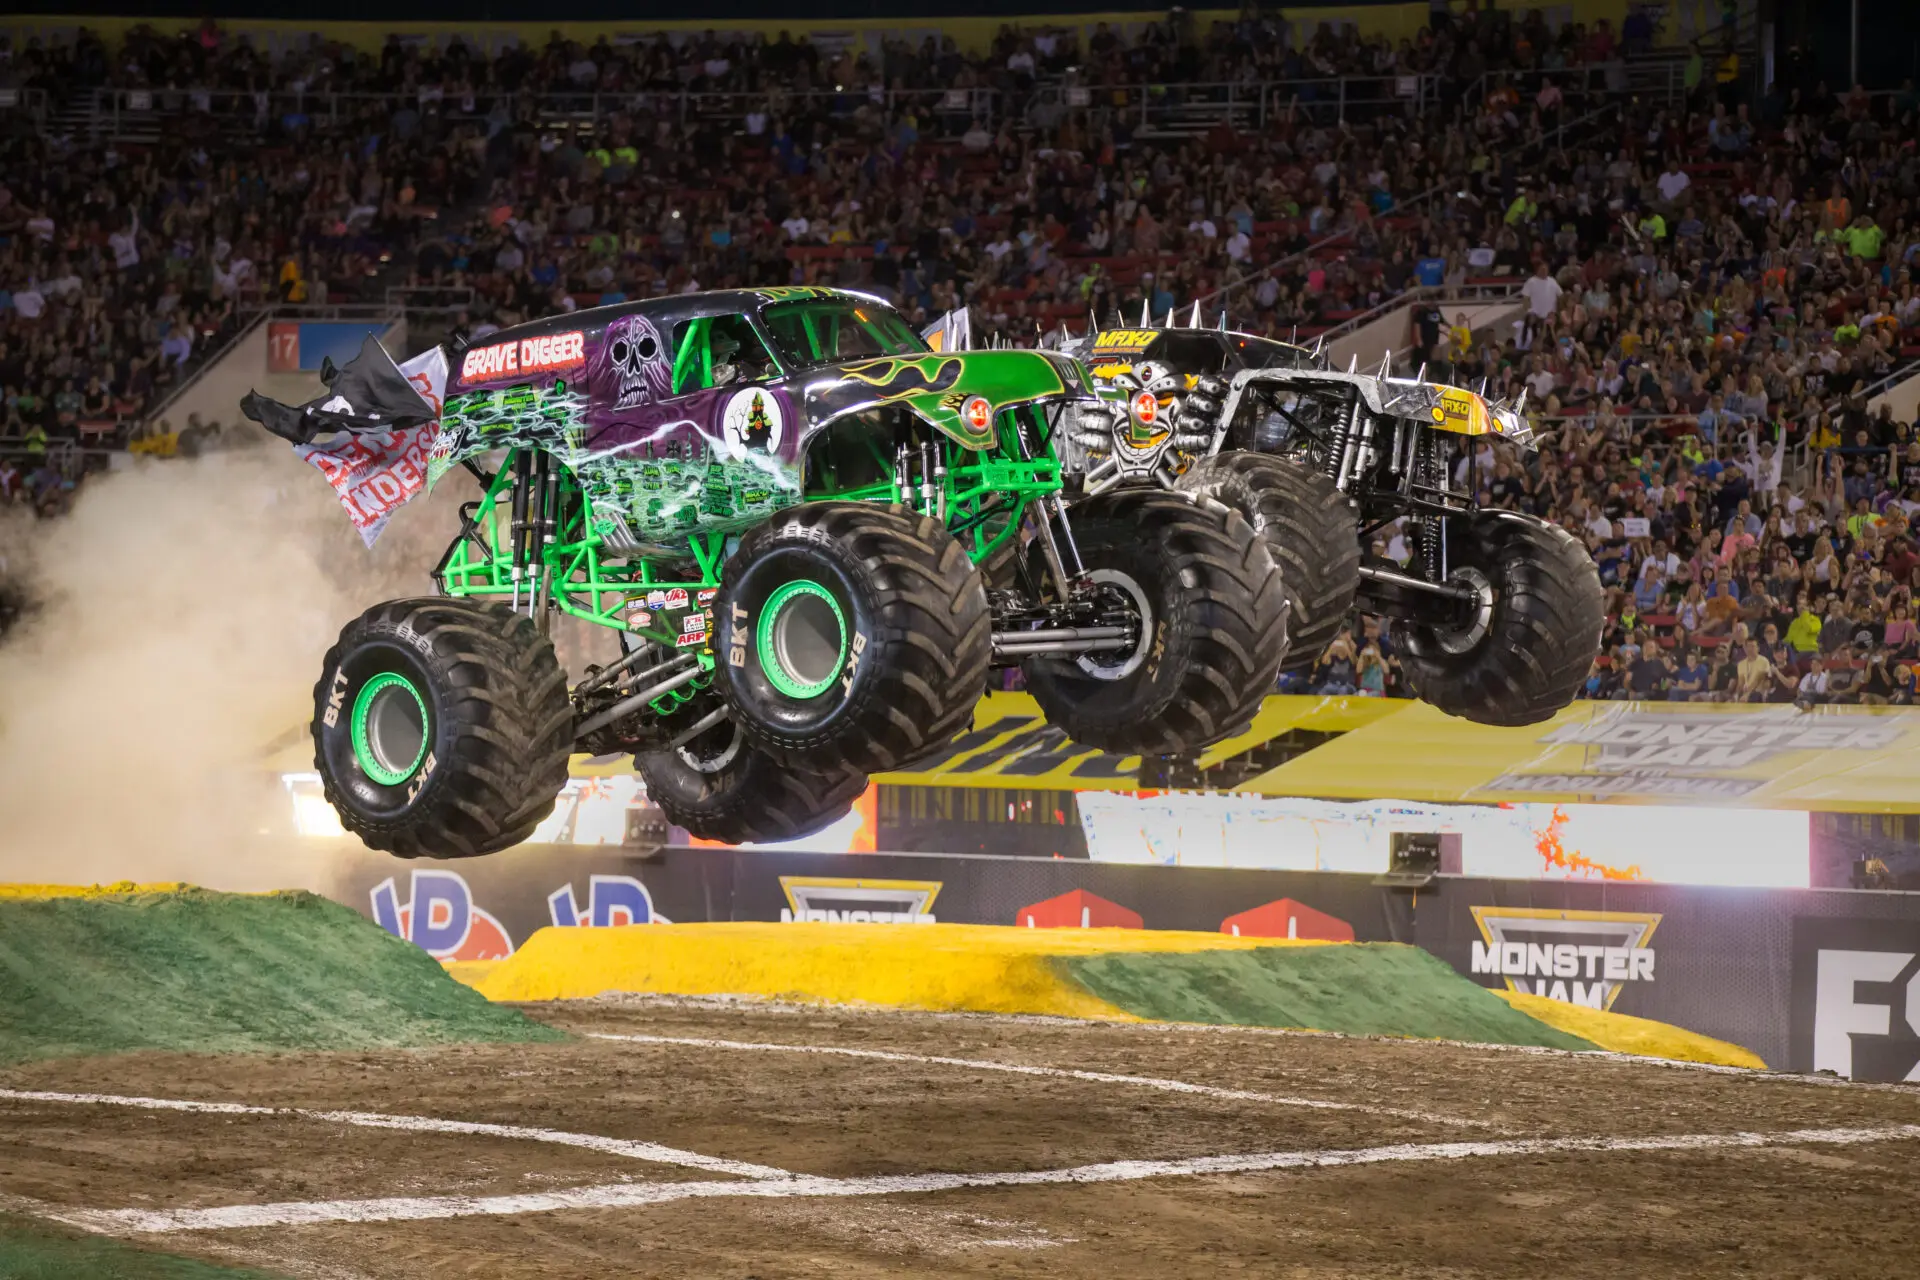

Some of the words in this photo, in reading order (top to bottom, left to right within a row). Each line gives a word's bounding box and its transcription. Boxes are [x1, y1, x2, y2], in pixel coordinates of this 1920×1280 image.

[269, 334, 298, 361] 17
[462, 341, 518, 379] GRAVE
[521, 331, 584, 368] DIGGER
[677, 632, 705, 645] ARP
[729, 601, 749, 668] BKT
[843, 631, 867, 697] BKT
[322, 666, 349, 729] BKT
[1535, 720, 1904, 750] MONSTER
[1595, 744, 1768, 769] JAM
[407, 750, 437, 806] BKT
[1471, 940, 1655, 981] MONSTER
